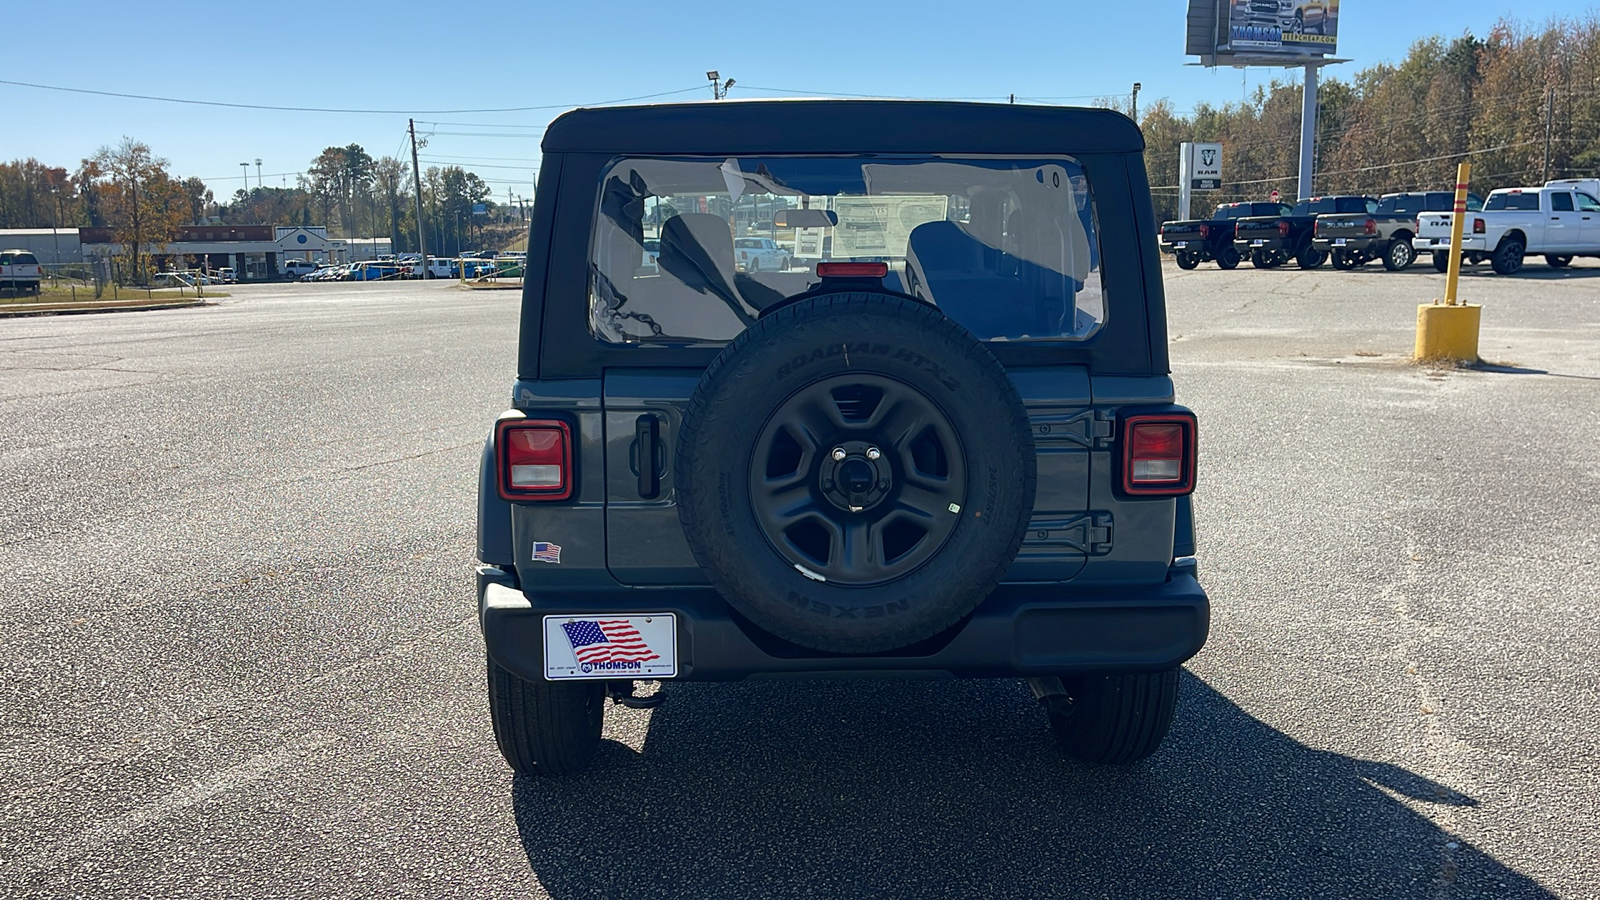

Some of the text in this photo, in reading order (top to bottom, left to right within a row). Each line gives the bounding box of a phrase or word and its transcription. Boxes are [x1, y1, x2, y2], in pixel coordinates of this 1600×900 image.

[1232, 26, 1283, 42] THOMSON
[1282, 34, 1336, 43] JEEPCHEAP.COM
[775, 342, 891, 380] ROADIAN
[786, 590, 910, 619] NEXEN
[593, 661, 641, 670] THOMSON
